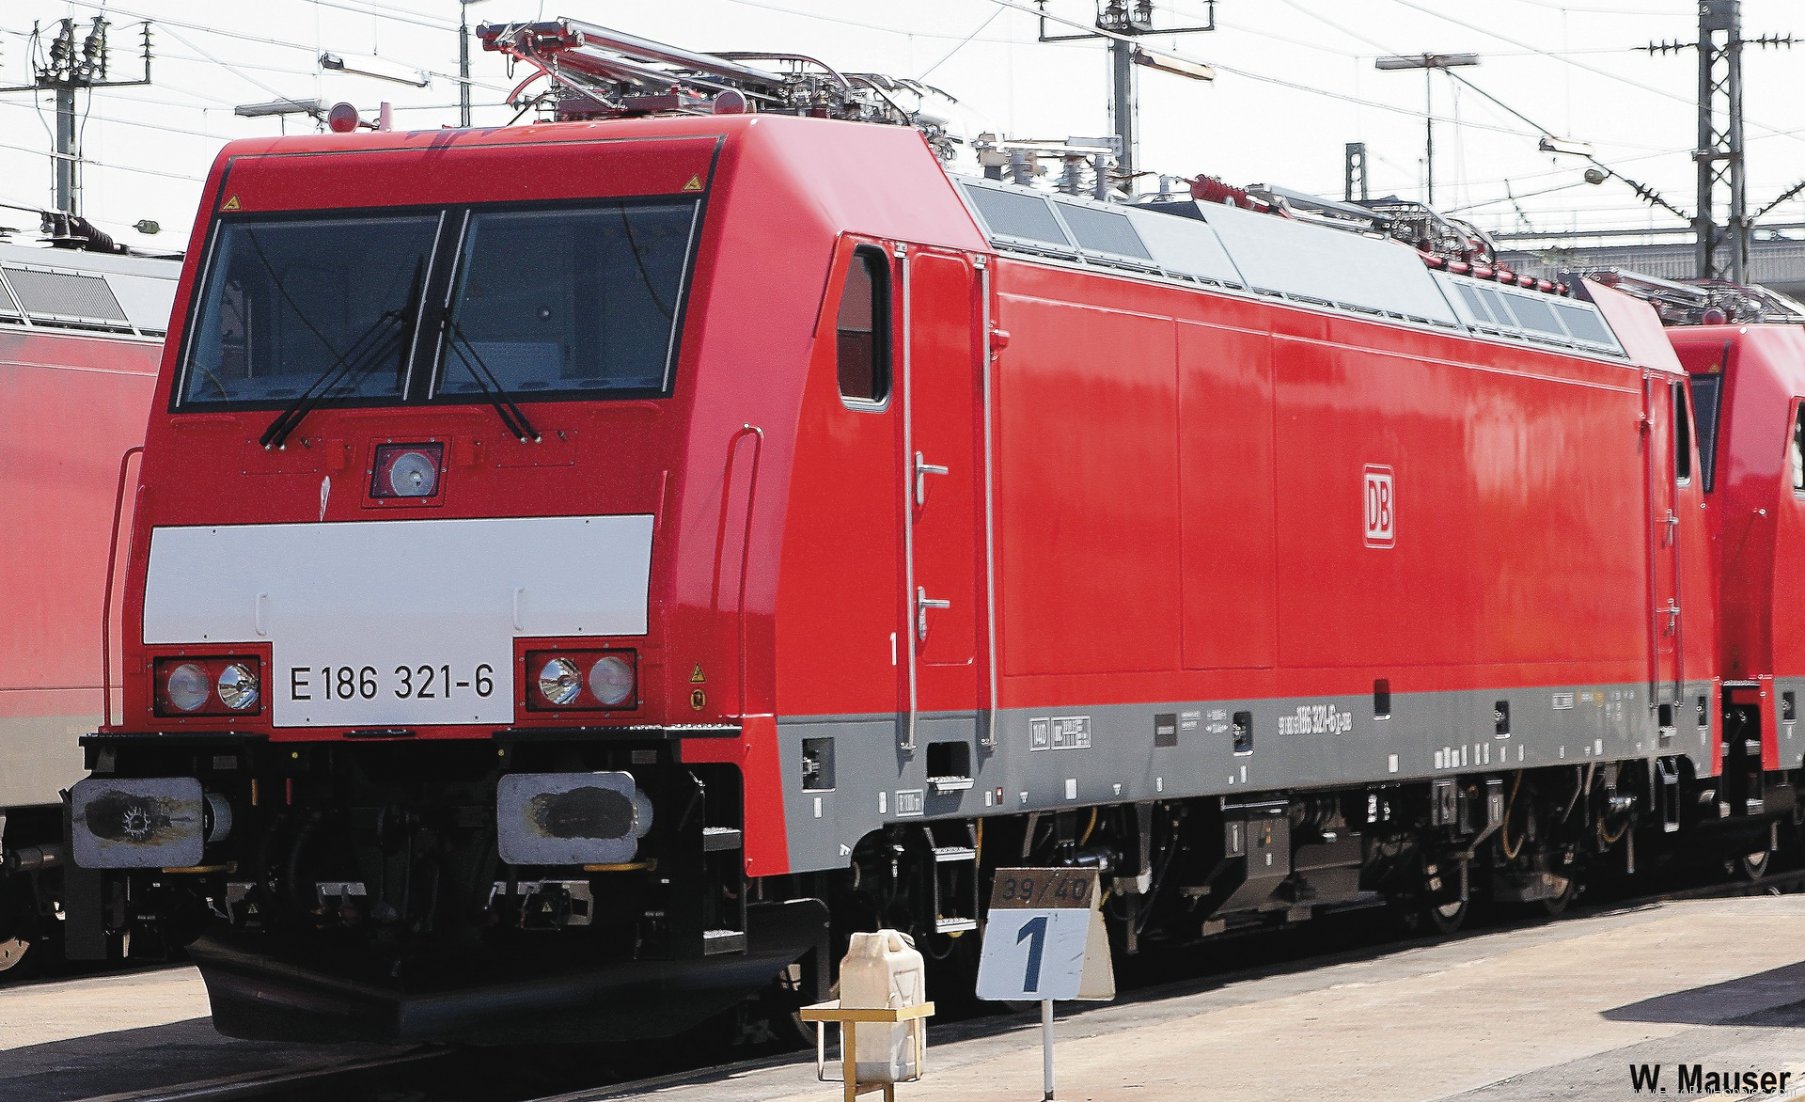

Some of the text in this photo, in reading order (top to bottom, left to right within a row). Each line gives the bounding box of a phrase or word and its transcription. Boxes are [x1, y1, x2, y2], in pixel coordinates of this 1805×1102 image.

[1366, 476, 1391, 535] DB
[291, 664, 494, 700] E 186 321-6
[1016, 916, 1049, 993] 1
